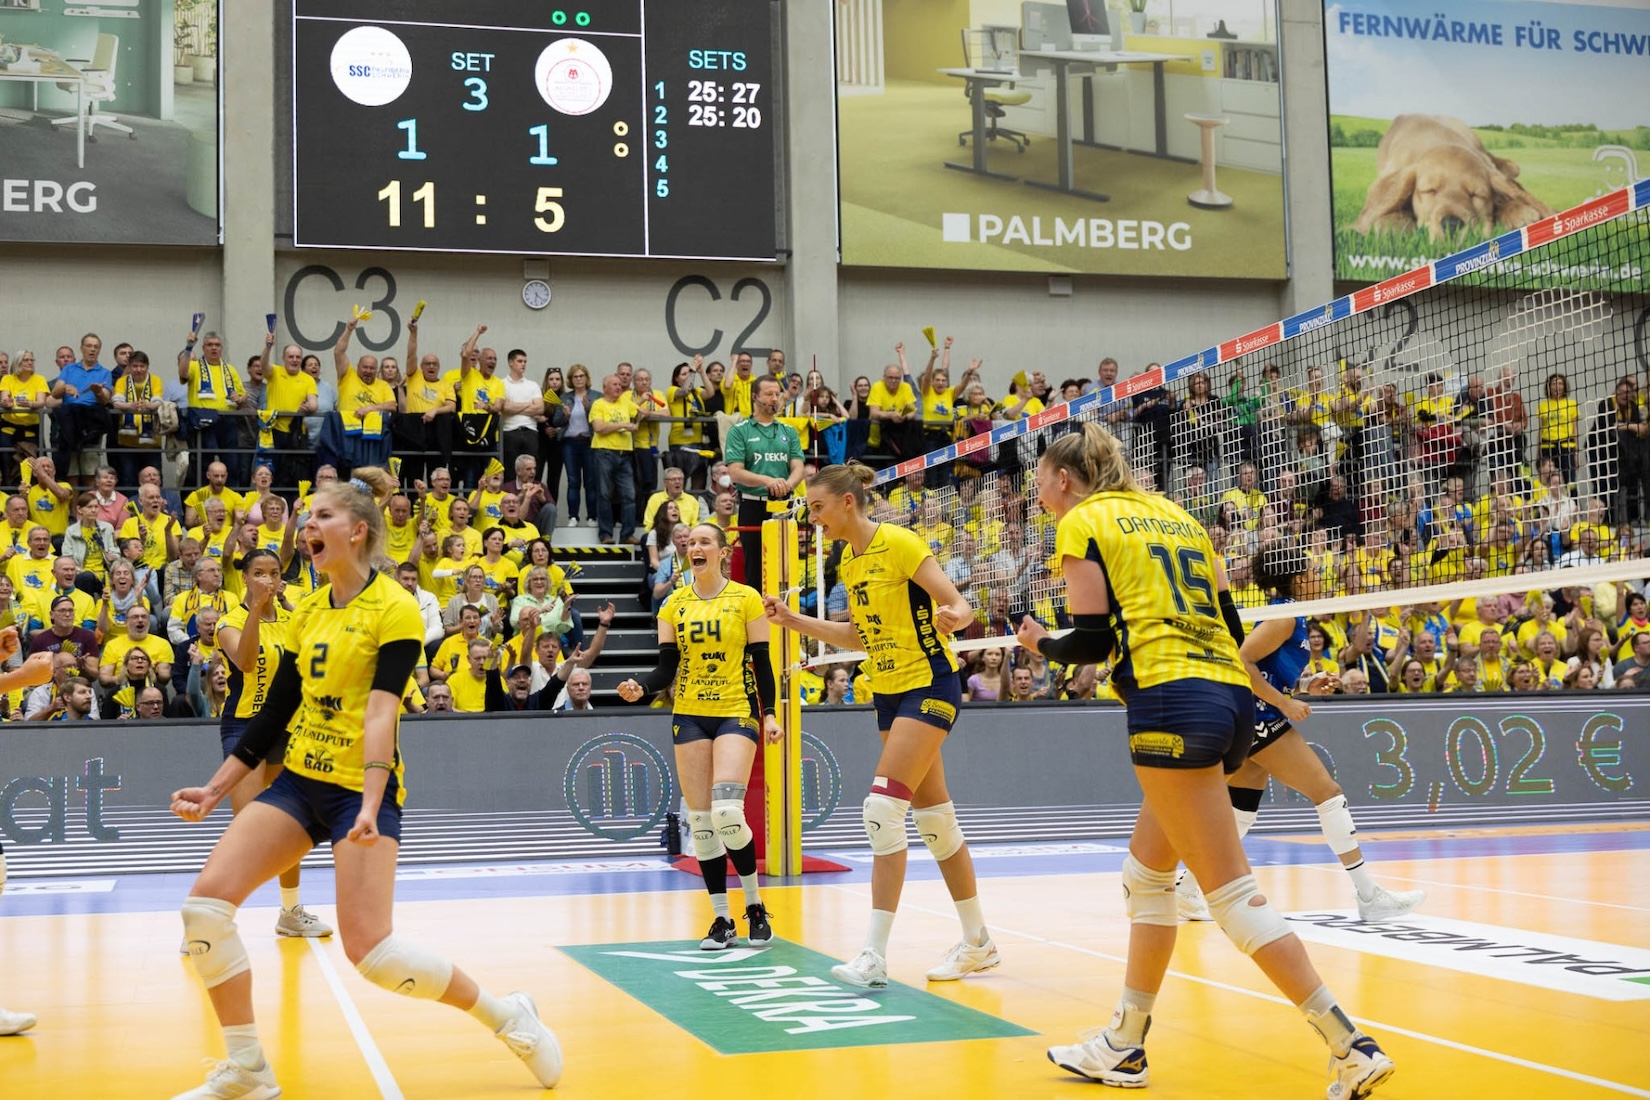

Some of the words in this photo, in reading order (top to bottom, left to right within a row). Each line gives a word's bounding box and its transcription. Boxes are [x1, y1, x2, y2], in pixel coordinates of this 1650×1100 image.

[1338, 12, 1504, 46] FERNWÄRME
[1515, 21, 1562, 50] FÜR
[1573, 30, 1650, 56] SCHW
[349, 64, 371, 77] SSC
[451, 51, 495, 72] SET
[688, 50, 747, 71] SETS
[462, 77, 489, 111] 3
[655, 81, 666, 99] 1
[732, 82, 761, 105] 27
[654, 106, 668, 125] 2
[732, 107, 762, 129] 20
[397, 118, 428, 160] 1
[529, 124, 559, 166] 1
[655, 130, 668, 149] 3
[655, 155, 669, 173] 4
[656, 179, 670, 198] 5
[377, 180, 435, 229] 11
[533, 186, 566, 233] 5
[1564, 204, 1609, 231] Sparkasse
[979, 214, 1193, 251] PALMBERG
[1455, 251, 1498, 275] PROVINZIAL
[1382, 280, 1416, 300] Sparkasse
[284, 265, 401, 353] C3
[665, 275, 773, 357] C2
[1242, 334, 1269, 351] Sparkasse
[764, 453, 788, 463] DEKRA
[1146, 543, 1219, 620] 15
[690, 620, 722, 643] 24
[310, 643, 329, 678] 2
[252, 657, 266, 714] PALMBE
[1362, 714, 1555, 813] 3,02
[1577, 712, 1633, 792] €
[1283, 913, 1650, 976] PALMBERG
[673, 965, 918, 1036] DEKRA
